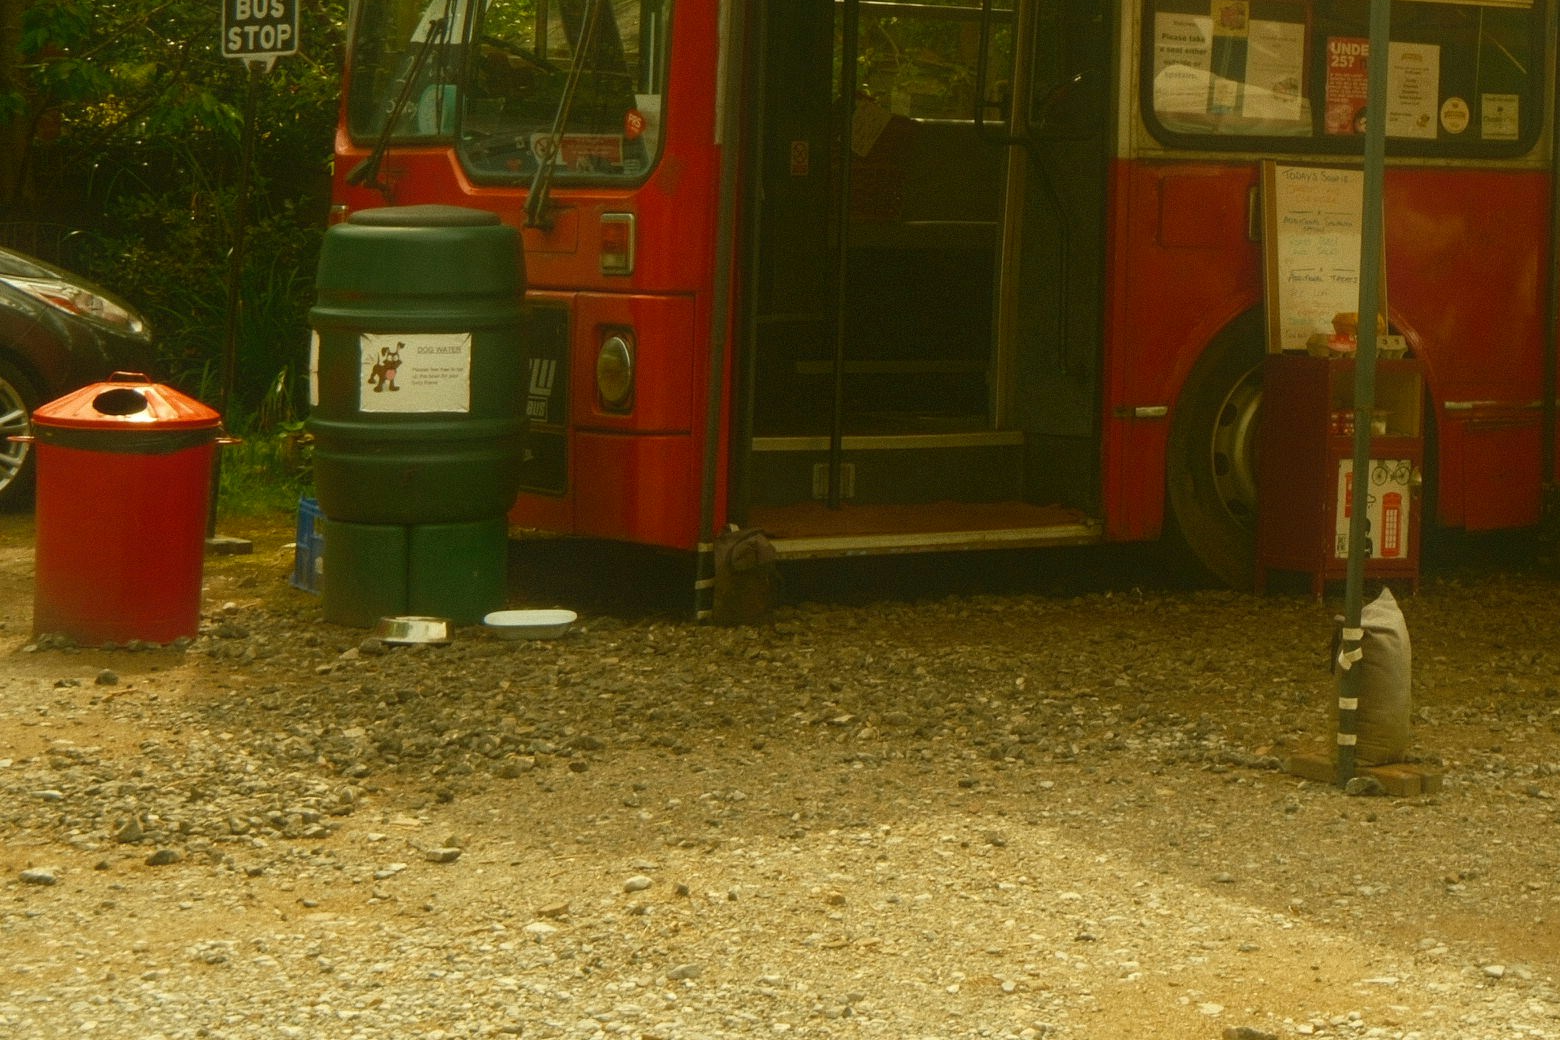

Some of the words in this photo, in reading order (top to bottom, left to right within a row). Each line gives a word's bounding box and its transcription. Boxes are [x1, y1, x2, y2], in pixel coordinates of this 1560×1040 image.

[228, 24, 292, 51] STOP
[1162, 32, 1187, 42] Please
[1189, 35, 1206, 43] take
[1166, 46, 1183, 54] seat
[1185, 47, 1207, 55] either
[1330, 41, 1370, 57] UNDE
[1331, 55, 1355, 68] 25?
[417, 346, 434, 354] DOG
[436, 346, 462, 354] WATER
